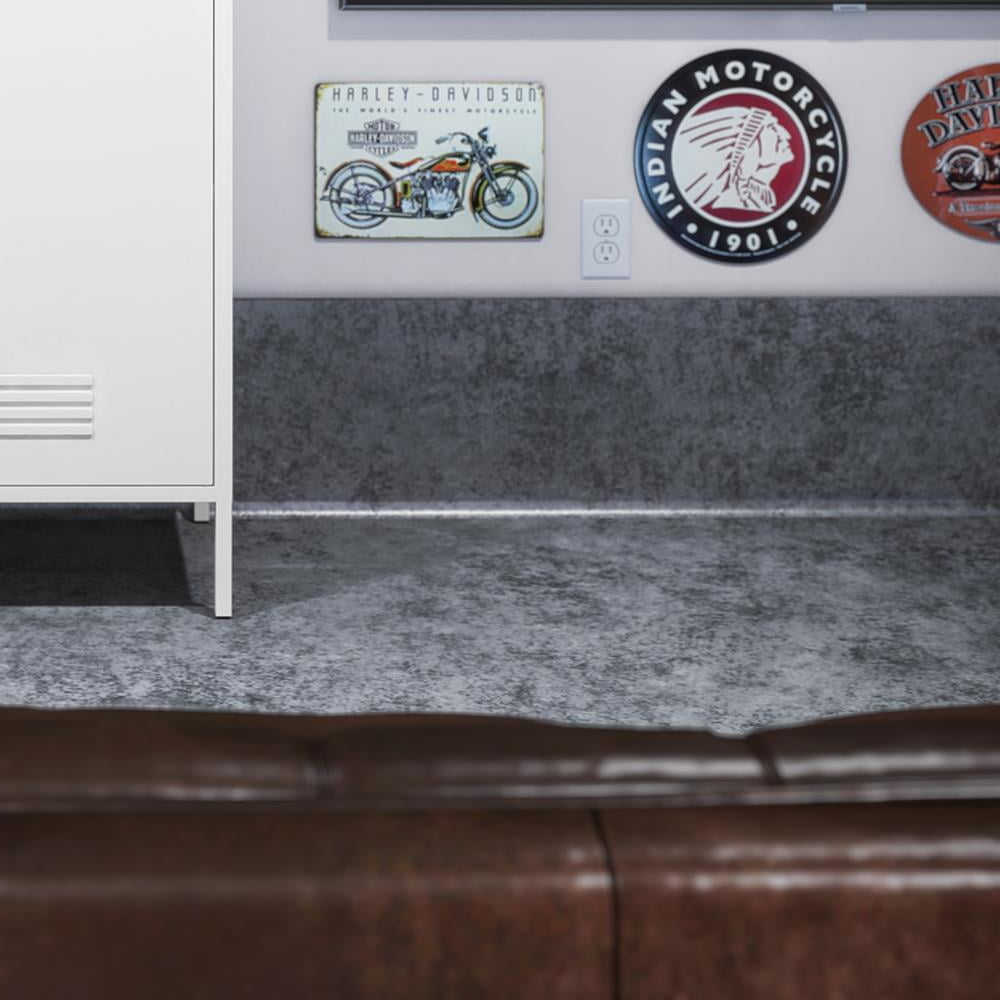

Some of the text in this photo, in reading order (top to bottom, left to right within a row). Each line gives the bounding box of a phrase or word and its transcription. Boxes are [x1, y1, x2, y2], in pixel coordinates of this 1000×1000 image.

[647, 60, 835, 219] INDIAN MOTORCYCLE
[709, 228, 778, 251] 1901
